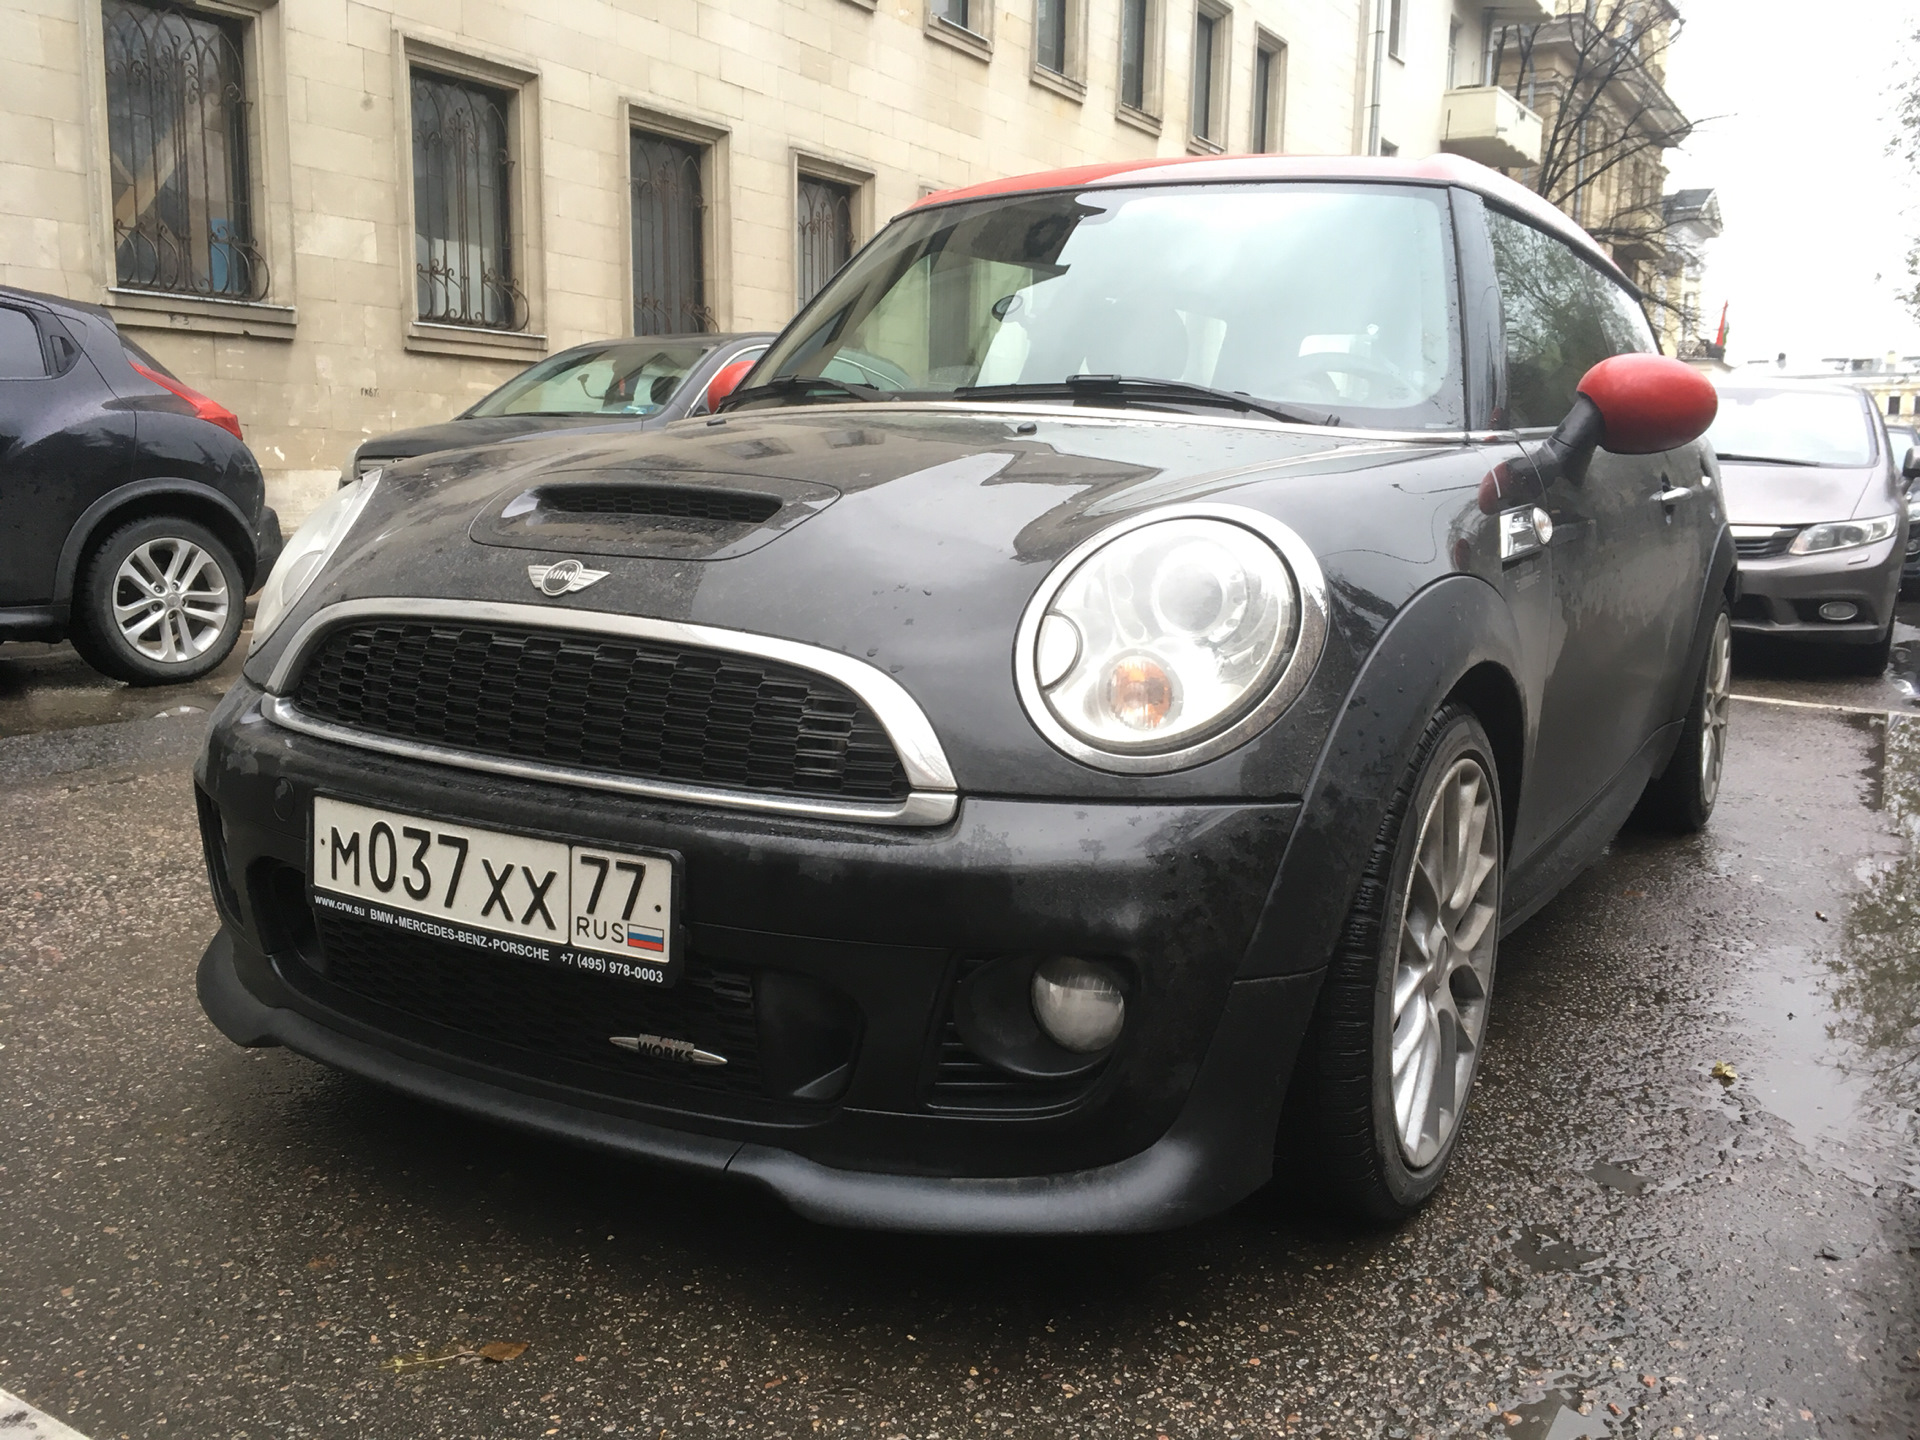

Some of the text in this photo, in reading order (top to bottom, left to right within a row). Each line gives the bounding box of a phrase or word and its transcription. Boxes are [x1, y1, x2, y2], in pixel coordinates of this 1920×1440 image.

[547, 570, 574, 581] MINI
[331, 821, 557, 930] M037XX
[580, 853, 646, 921] 77
[314, 895, 365, 916] www.crw.su
[560, 953, 574, 965] +7
[577, 953, 606, 973] (495)
[609, 961, 663, 984] 978-0003
[576, 916, 625, 944] RUS
[638, 1041, 694, 1063] WORKS
